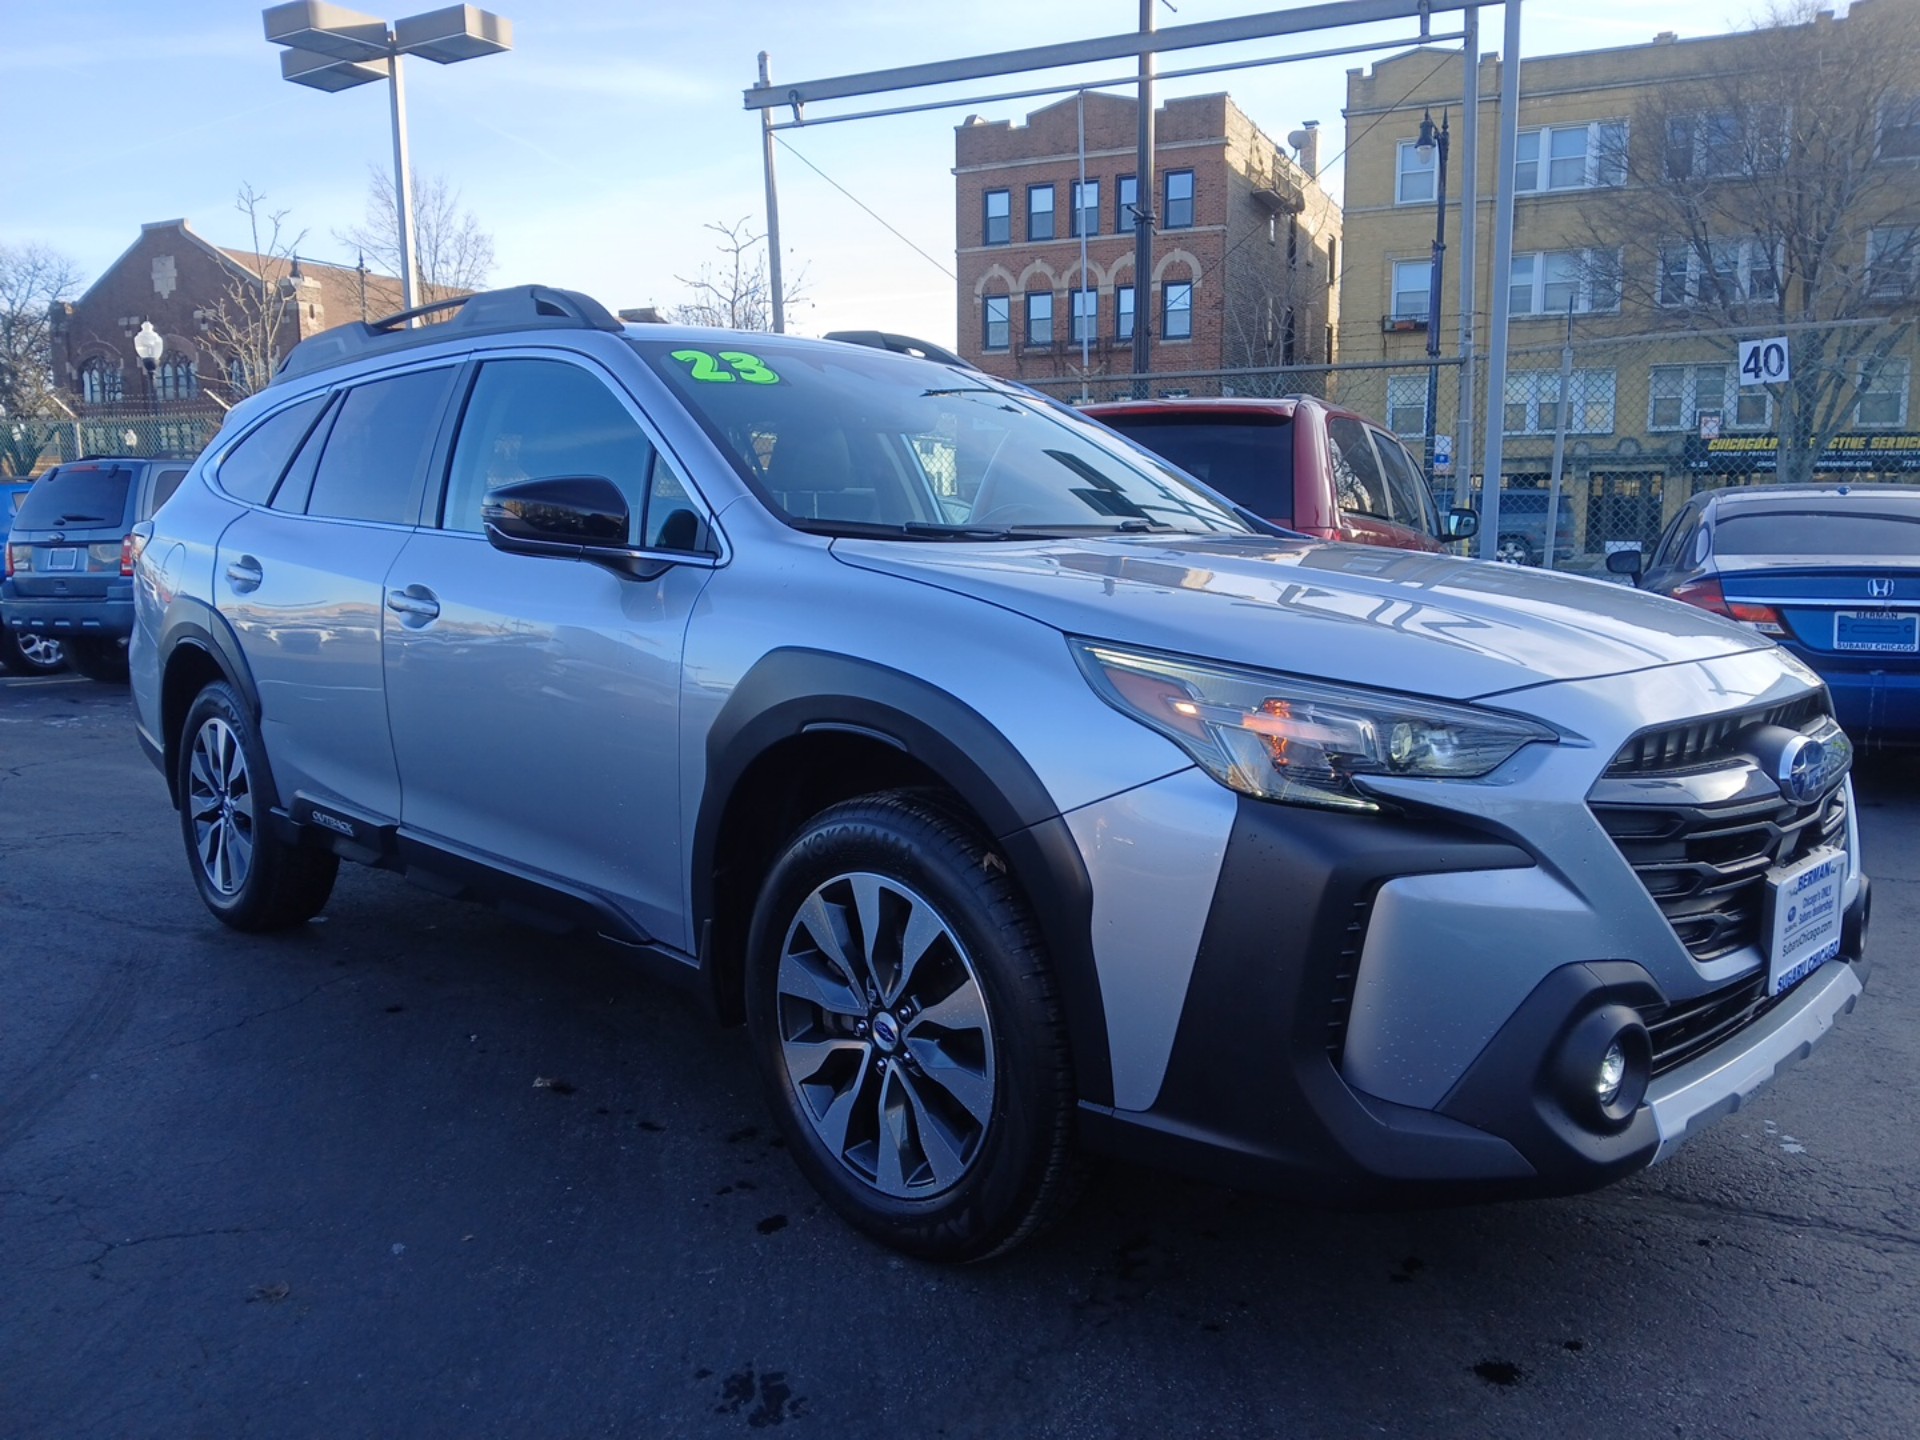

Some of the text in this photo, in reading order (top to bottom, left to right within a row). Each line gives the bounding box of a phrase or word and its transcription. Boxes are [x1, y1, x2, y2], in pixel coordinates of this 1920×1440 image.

[671, 350, 780, 385] 23
[1743, 343, 1785, 379] 40
[1708, 437, 1792, 451] CHICAGOLA
[1856, 612, 1898, 620] BERMAN
[1837, 641, 1916, 651] SUBARU CHICAGO
[312, 810, 353, 835] OUTBACK
[802, 823, 914, 860] YOKOHAMA
[1798, 861, 1832, 890] BERMAN
[1782, 920, 1833, 958] SubaruChicago.com
[1777, 940, 1839, 994] SUBARU CHICAGO
